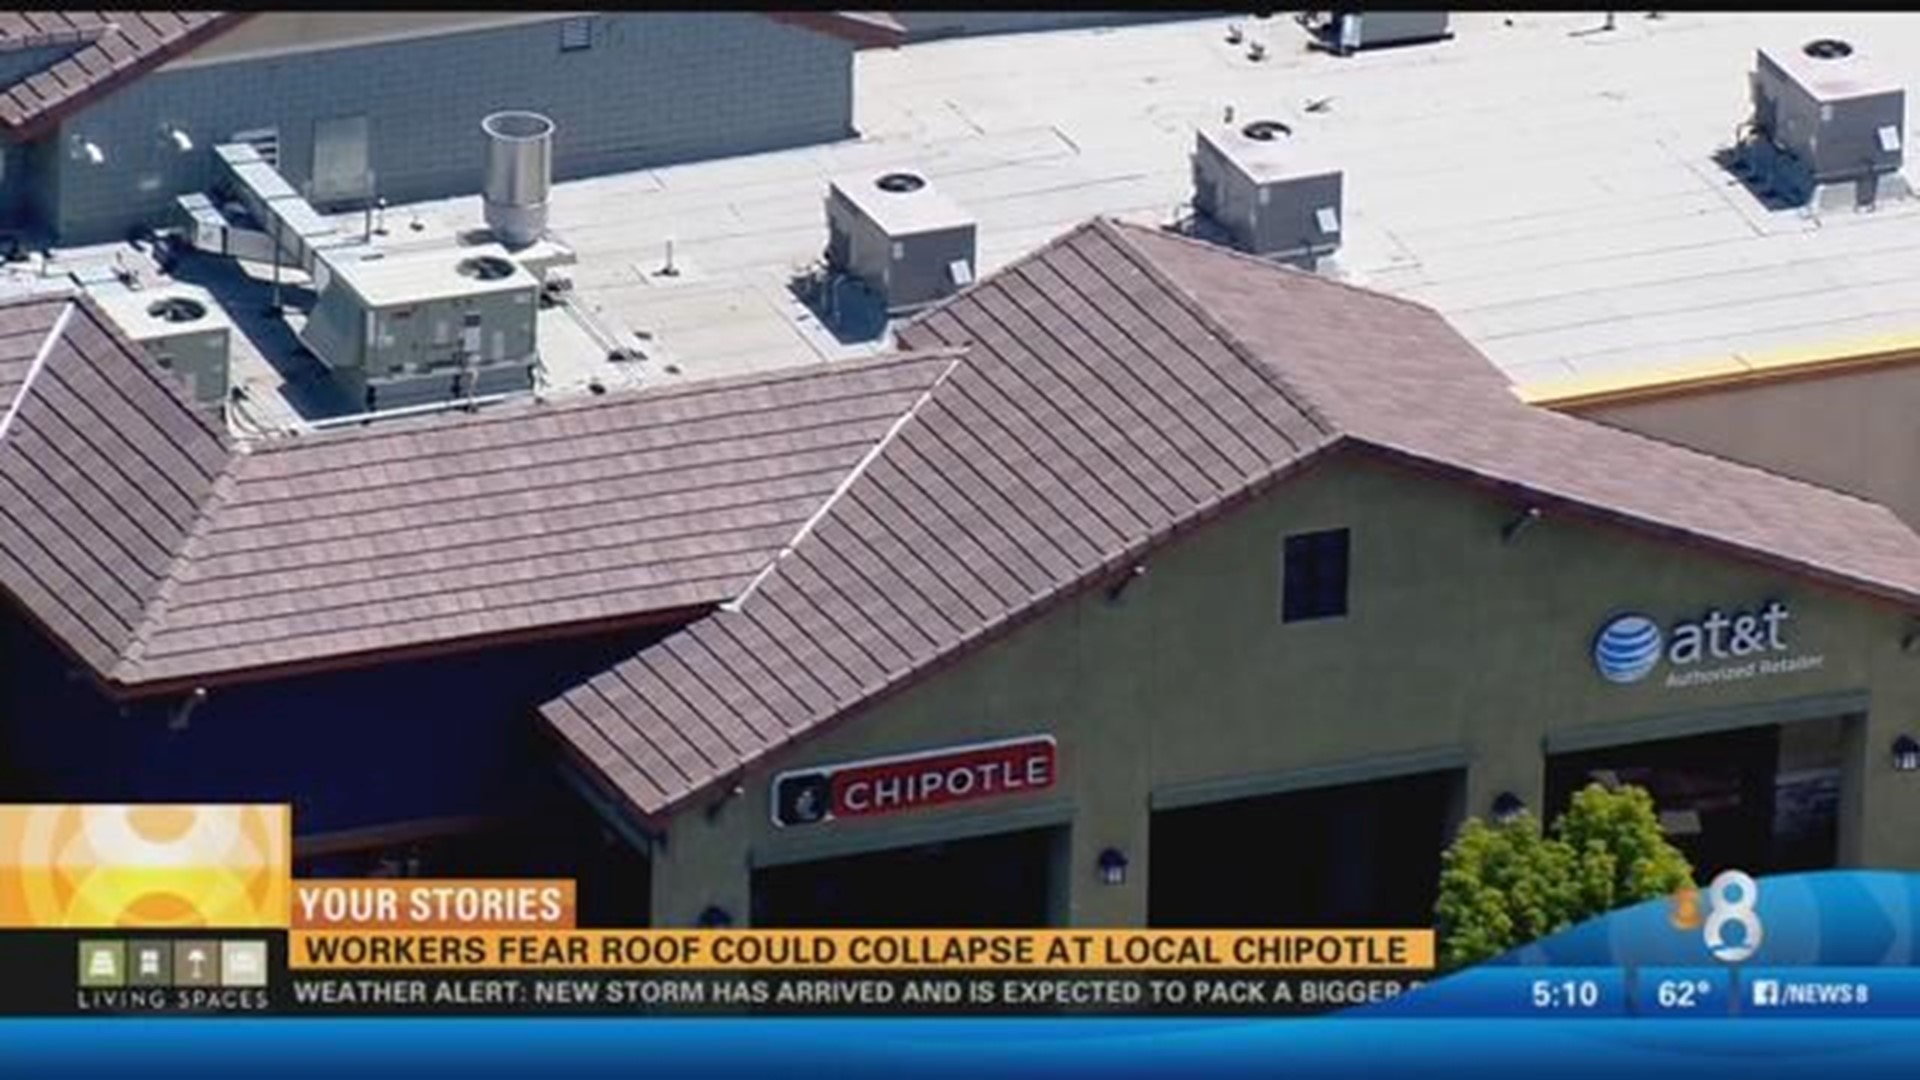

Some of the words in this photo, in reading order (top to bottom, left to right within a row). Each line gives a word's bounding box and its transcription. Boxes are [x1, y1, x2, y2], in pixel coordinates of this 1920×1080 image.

[1668, 602, 1788, 664] at&t
[1665, 662, 1754, 688] Authorized
[1759, 654, 1825, 676] Retailer
[844, 756, 1048, 810] CHIPOTLE
